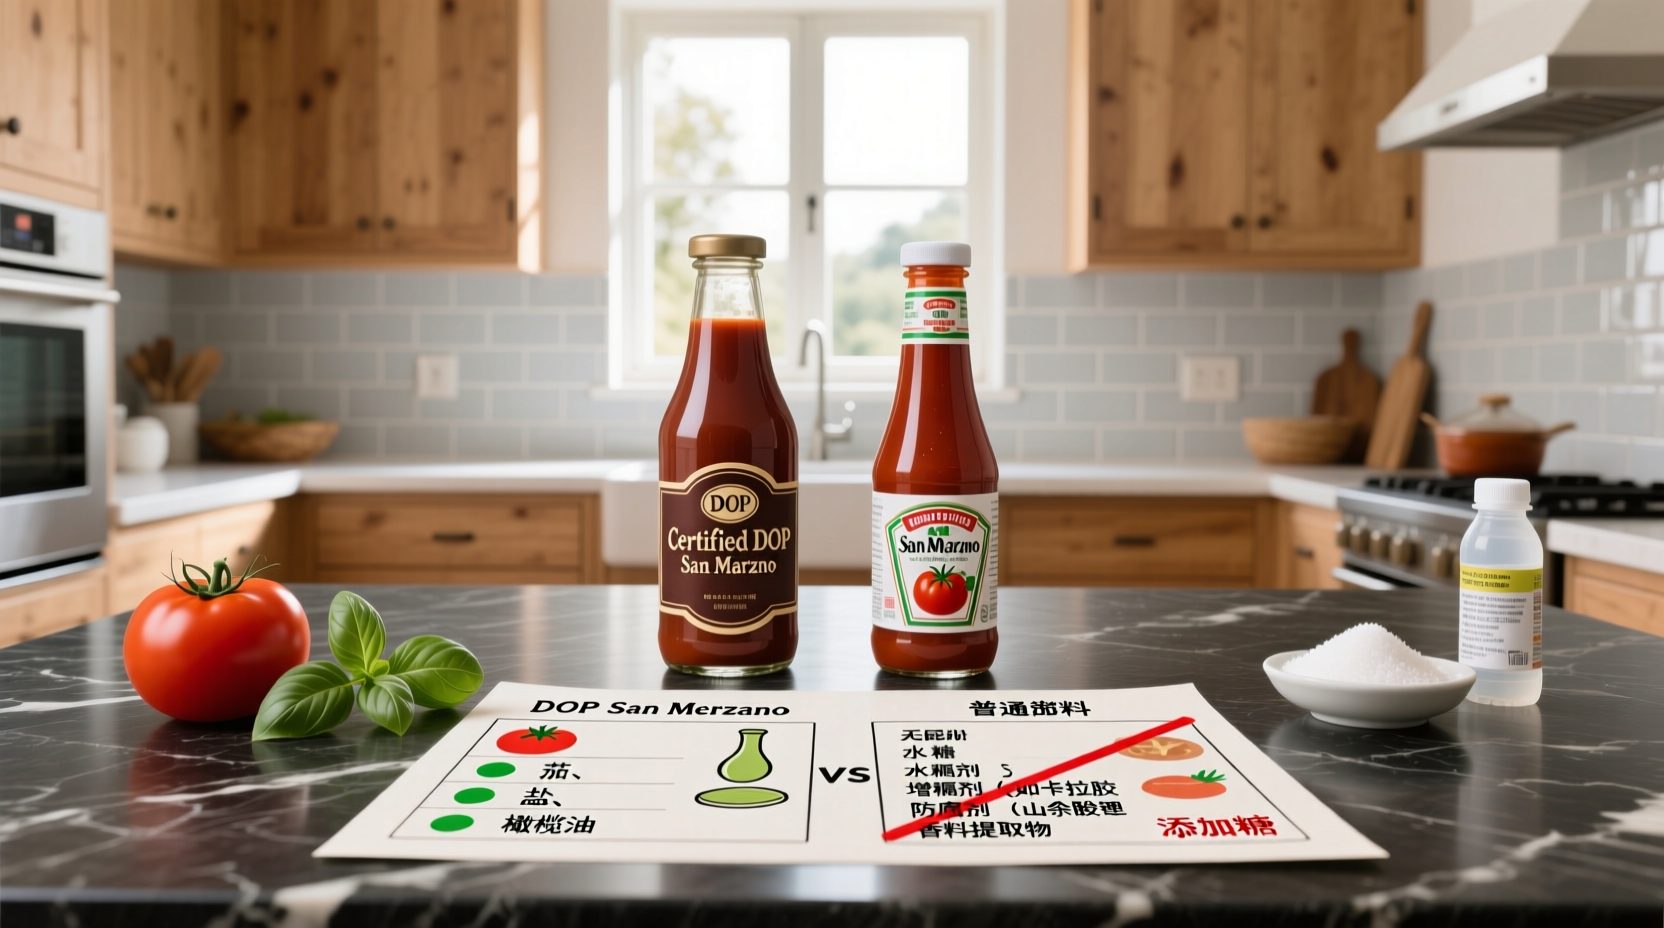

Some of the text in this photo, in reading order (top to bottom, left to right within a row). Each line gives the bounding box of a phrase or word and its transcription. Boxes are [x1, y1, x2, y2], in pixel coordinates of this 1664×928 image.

[710, 494, 751, 513] DOP
[667, 526, 791, 552] Certified DOP
[898, 535, 925, 553] San
[680, 554, 711, 574] San
[530, 700, 790, 717] DOP San Merzano
[519, 786, 562, 807] 盐、
[501, 813, 596, 834] 橄榄油
[1157, 814, 1278, 839] 添加糖
